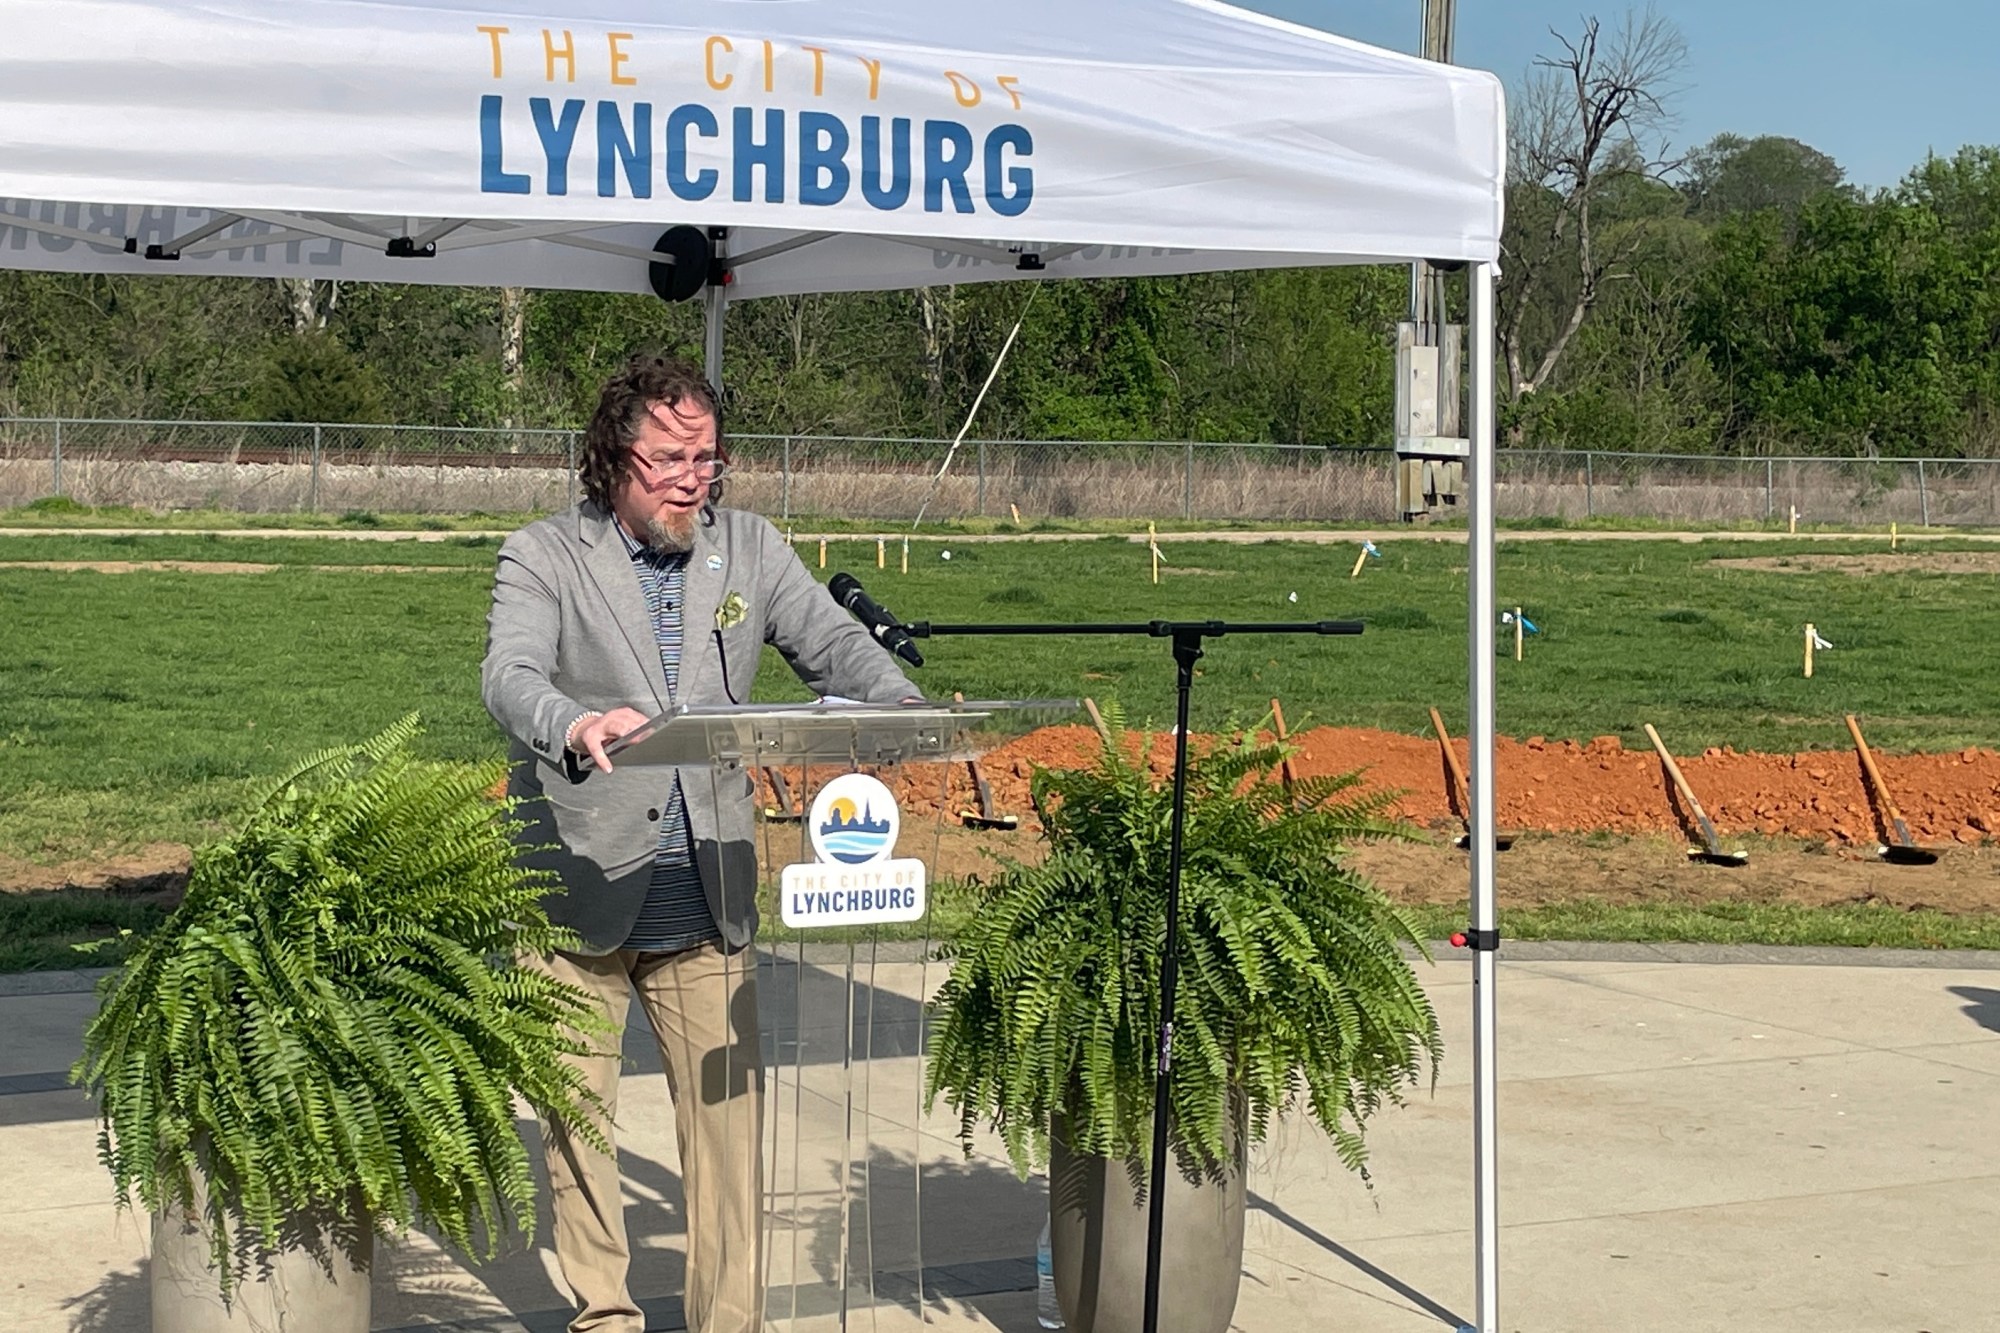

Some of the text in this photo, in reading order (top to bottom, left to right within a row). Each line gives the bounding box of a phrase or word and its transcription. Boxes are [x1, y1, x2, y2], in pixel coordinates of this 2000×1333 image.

[476, 25, 1024, 111] THE CITY OF
[479, 94, 1034, 217] LYNCHBURG
[792, 869, 916, 891] THE CITY OF
[793, 887, 915, 915] LYNCHBURG
